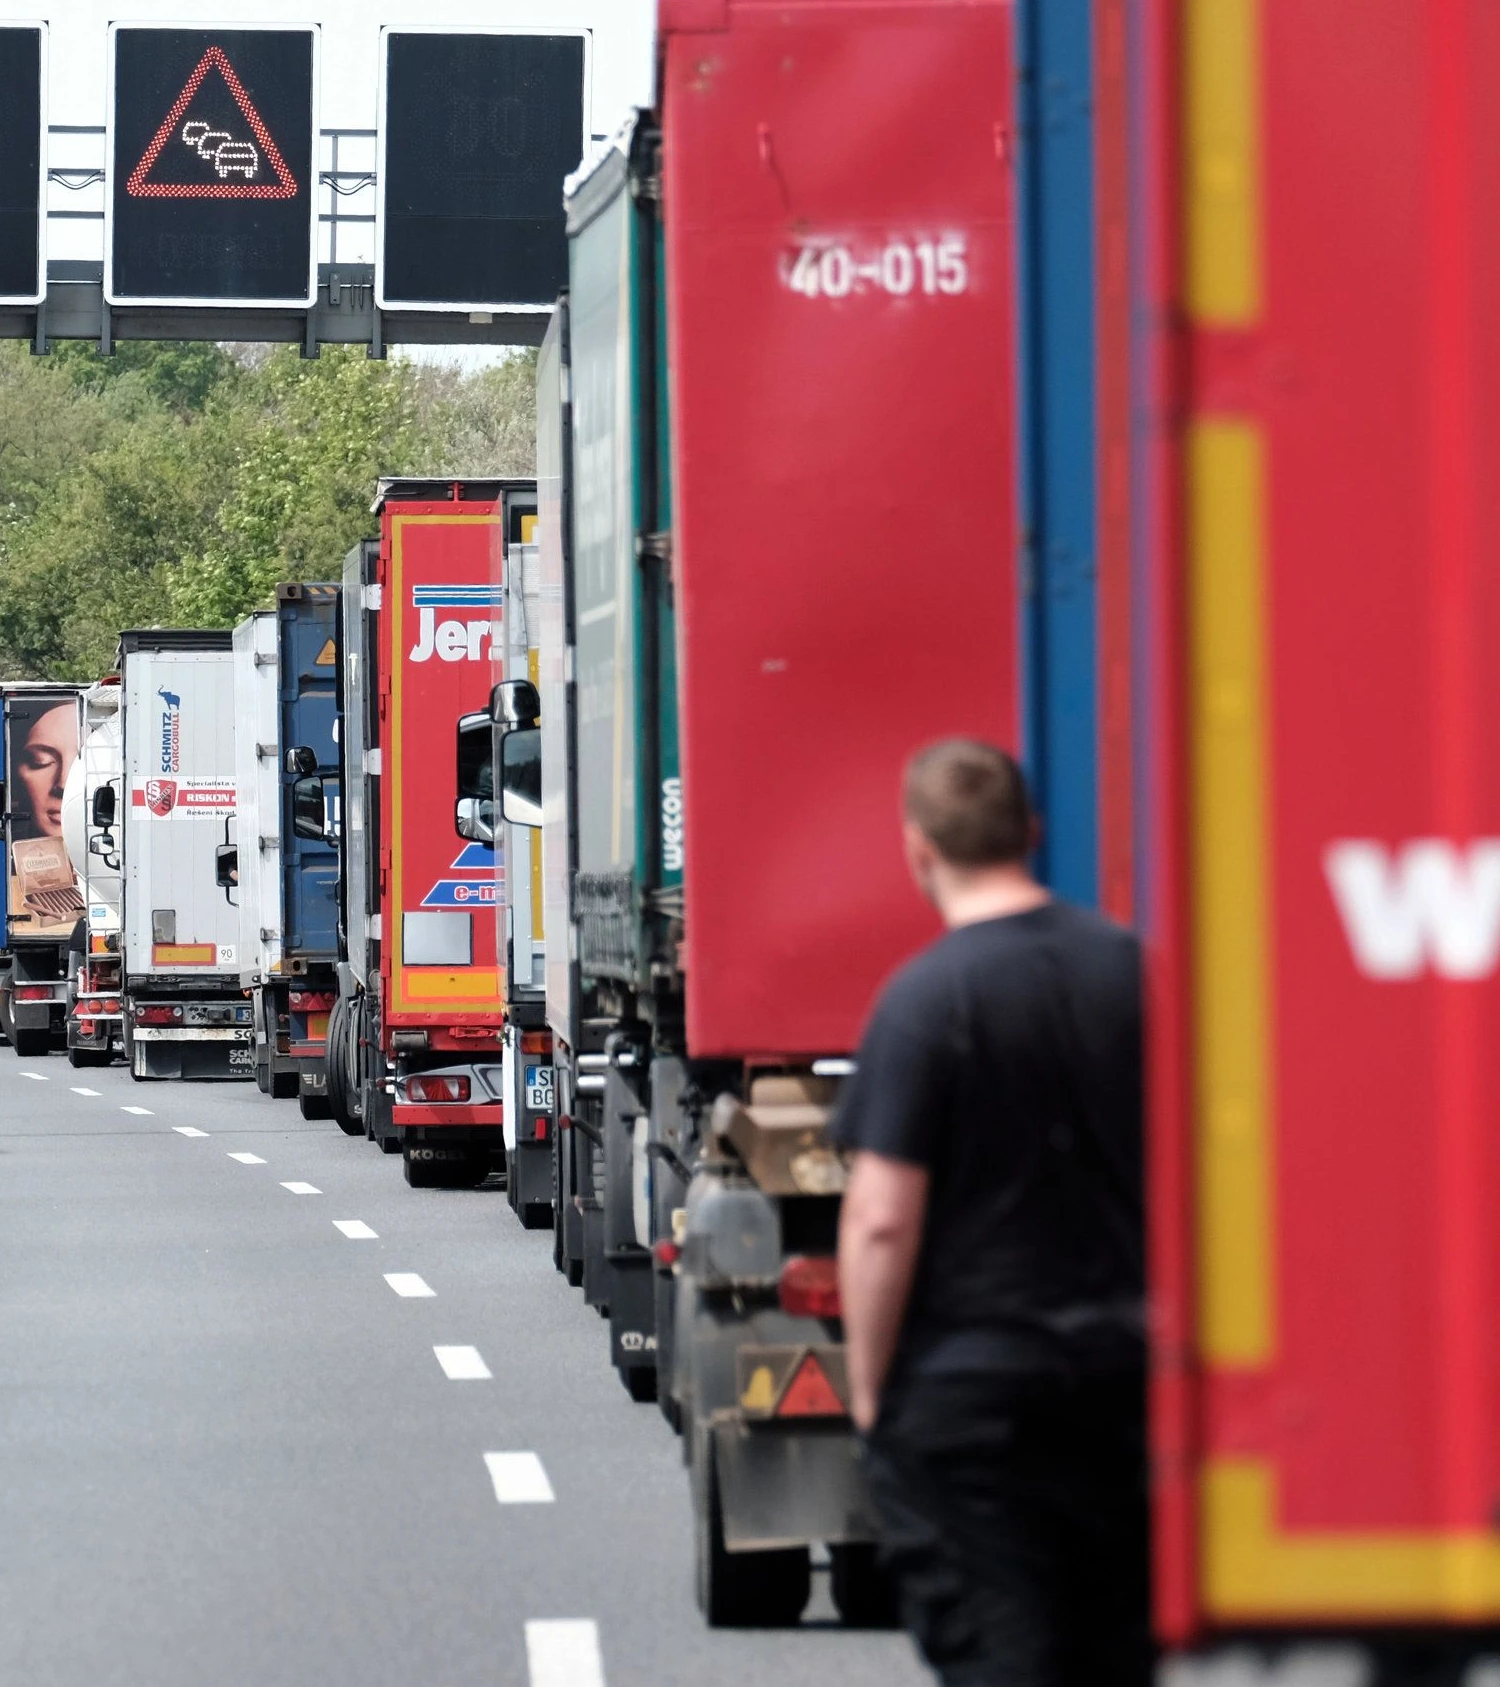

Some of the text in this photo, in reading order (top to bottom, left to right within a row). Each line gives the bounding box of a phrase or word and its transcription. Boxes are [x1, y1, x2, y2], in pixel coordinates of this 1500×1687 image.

[788, 242, 968, 297] 40-015
[408, 607, 502, 662] Jer
[161, 712, 172, 773] SCHMITZ
[171, 711, 180, 773] CARGOBULL
[186, 793, 230, 803] RISKON
[662, 778, 682, 871] wecon
[220, 949, 233, 959] 90
